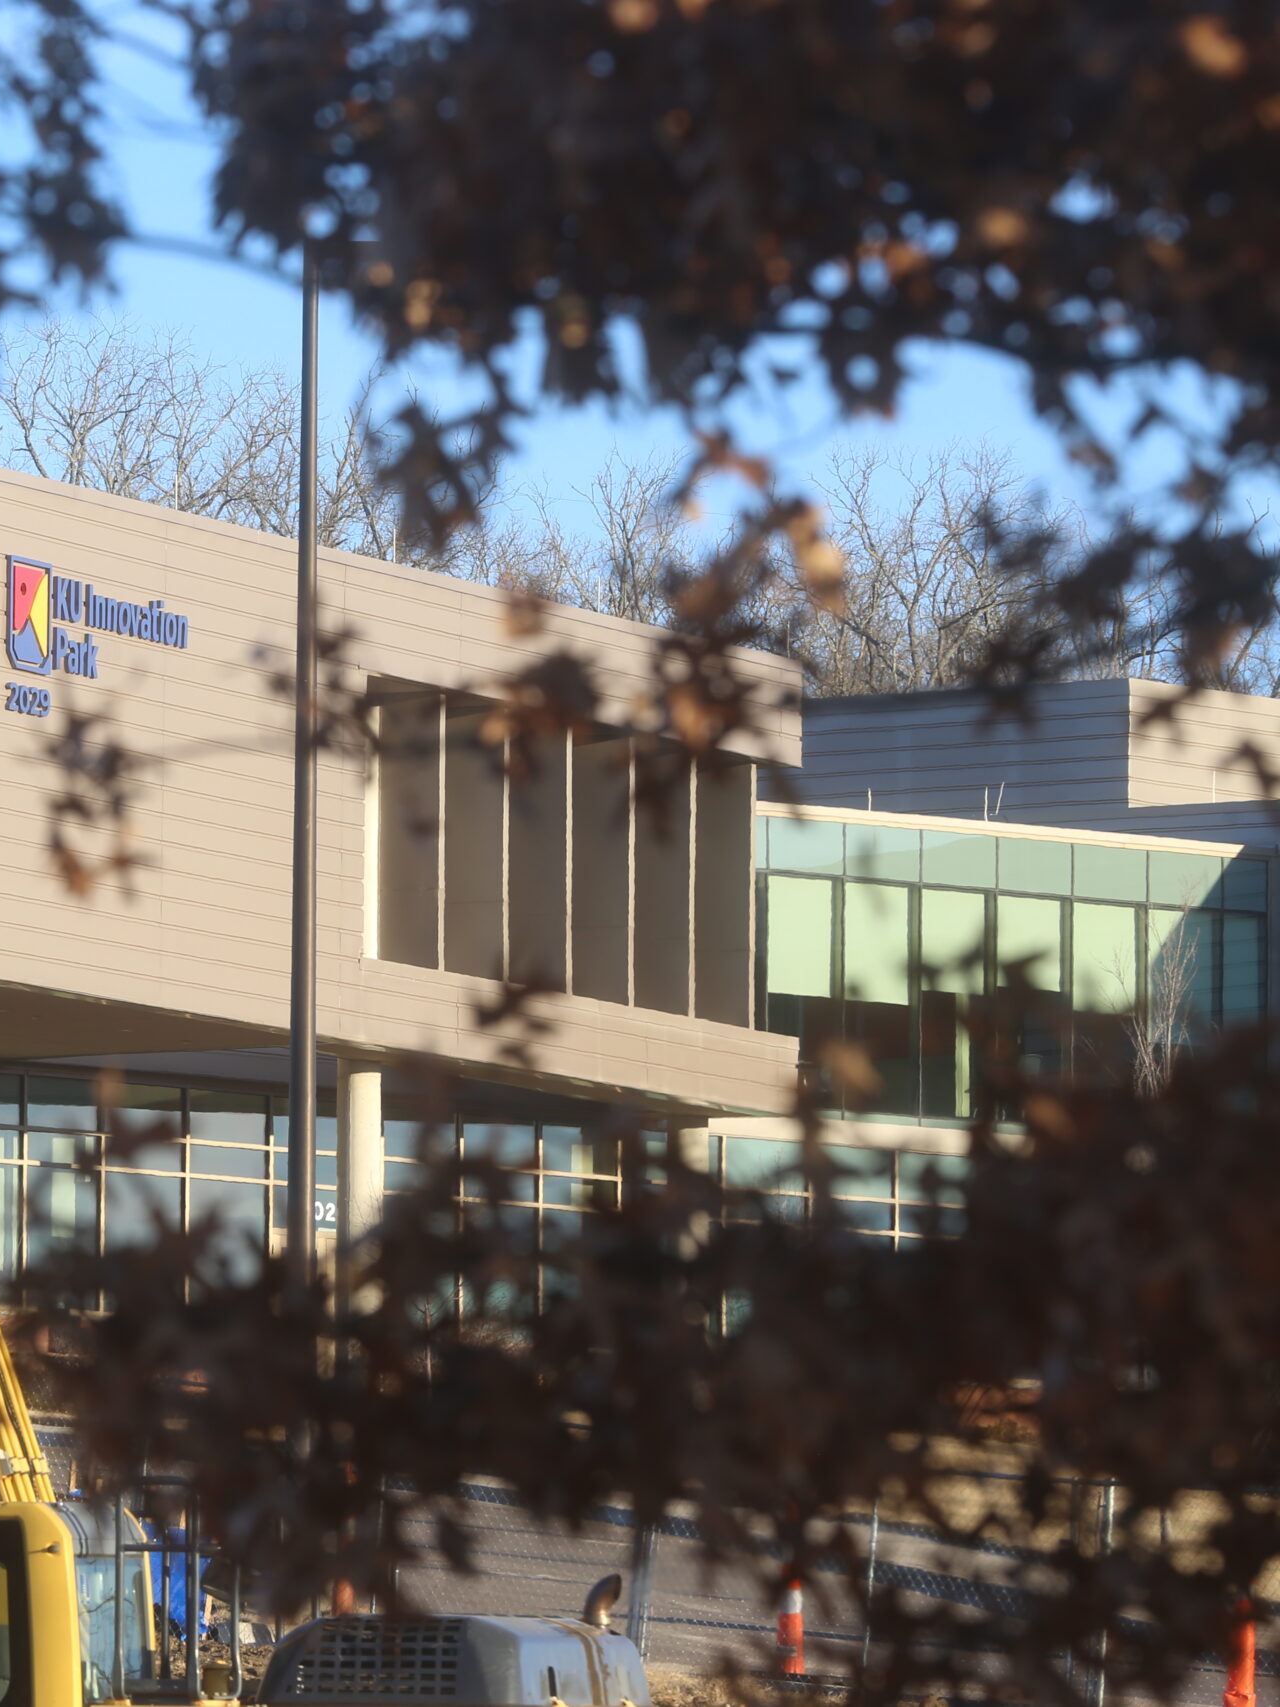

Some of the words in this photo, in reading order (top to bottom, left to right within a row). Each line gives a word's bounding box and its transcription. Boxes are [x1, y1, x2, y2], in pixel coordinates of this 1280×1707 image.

[52, 575, 83, 623] KU
[84, 583, 189, 649] Innovation
[51, 626, 99, 679] Park
[4, 681, 51, 717] 2029
